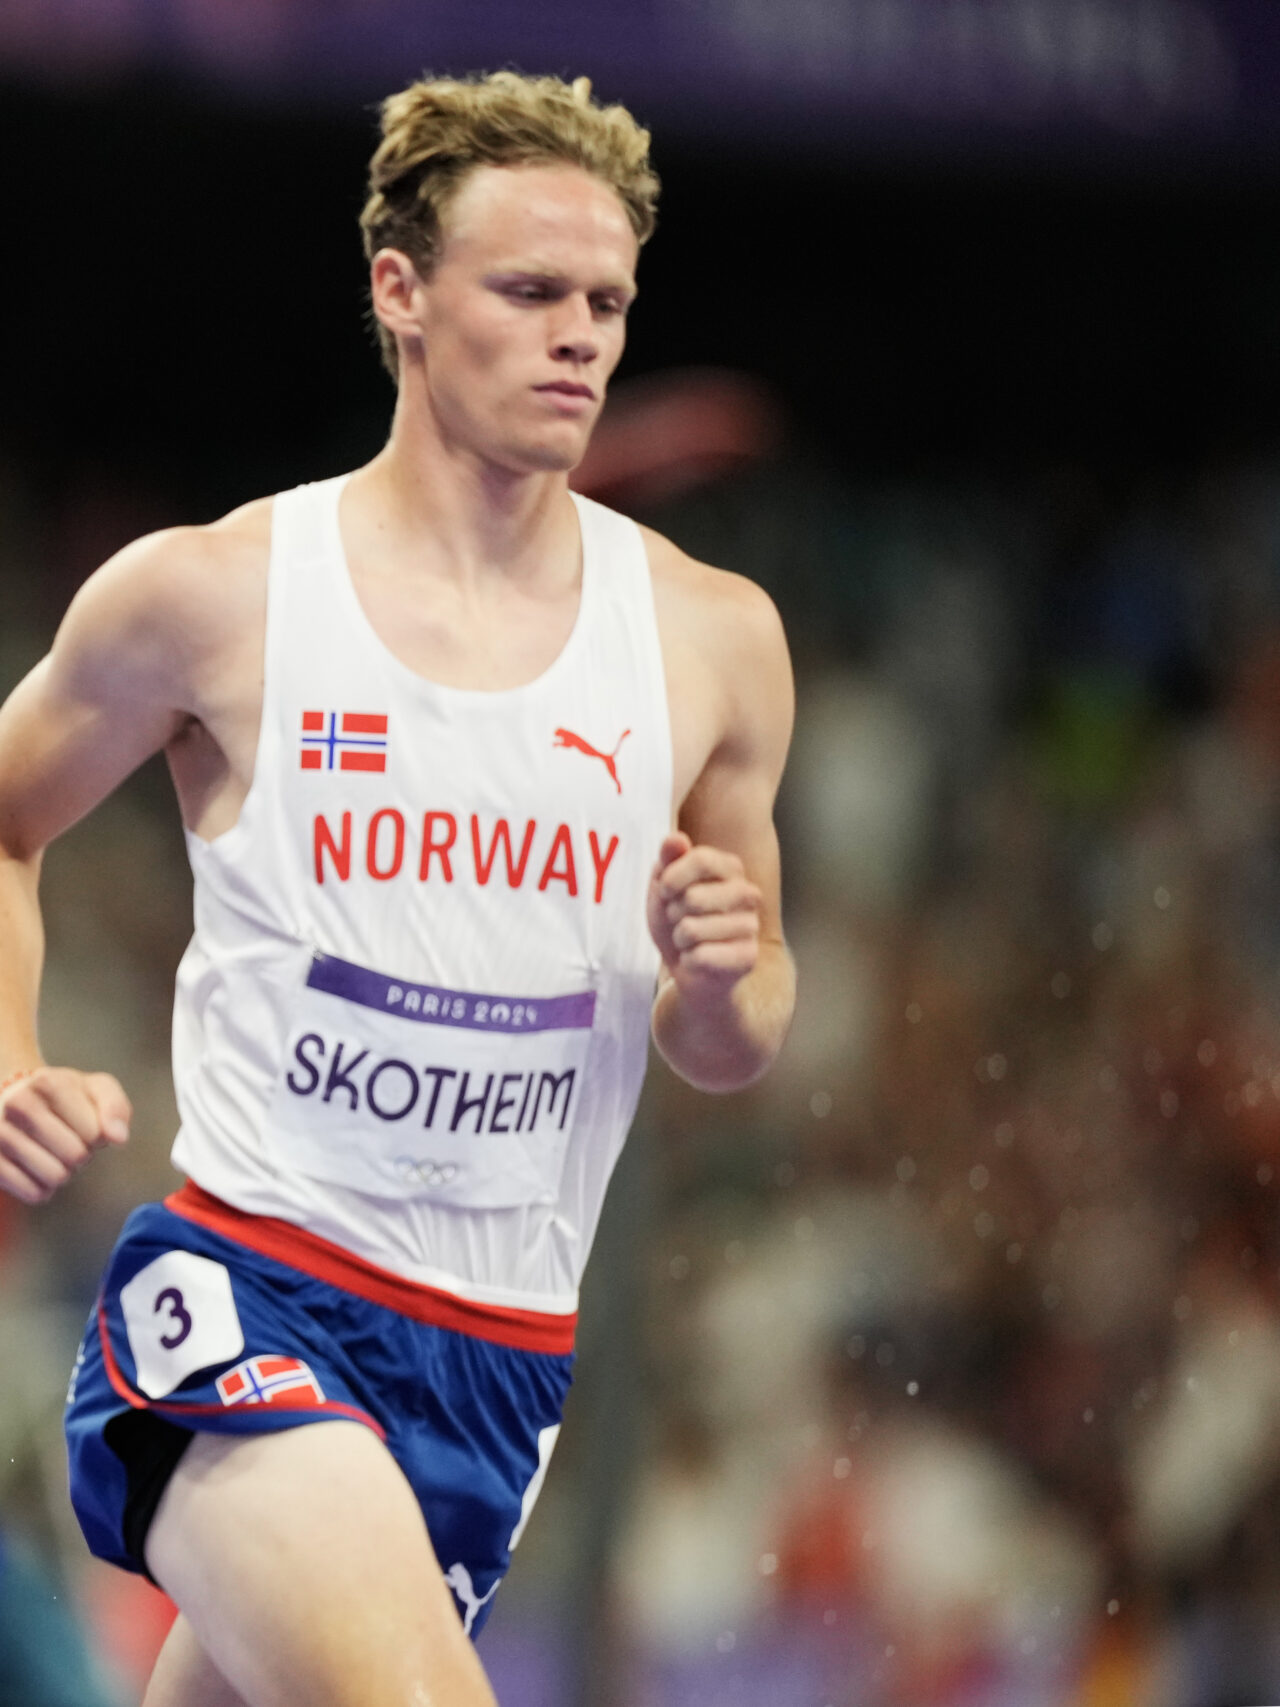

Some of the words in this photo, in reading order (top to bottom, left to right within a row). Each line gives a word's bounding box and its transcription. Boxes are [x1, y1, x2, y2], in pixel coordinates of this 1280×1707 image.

[314, 808, 619, 904] NORWAY
[386, 984, 467, 1019] PARIS
[473, 1000, 538, 1027] 2024
[286, 1033, 576, 1135] SKOTHEIM
[153, 1287, 193, 1350] 3
